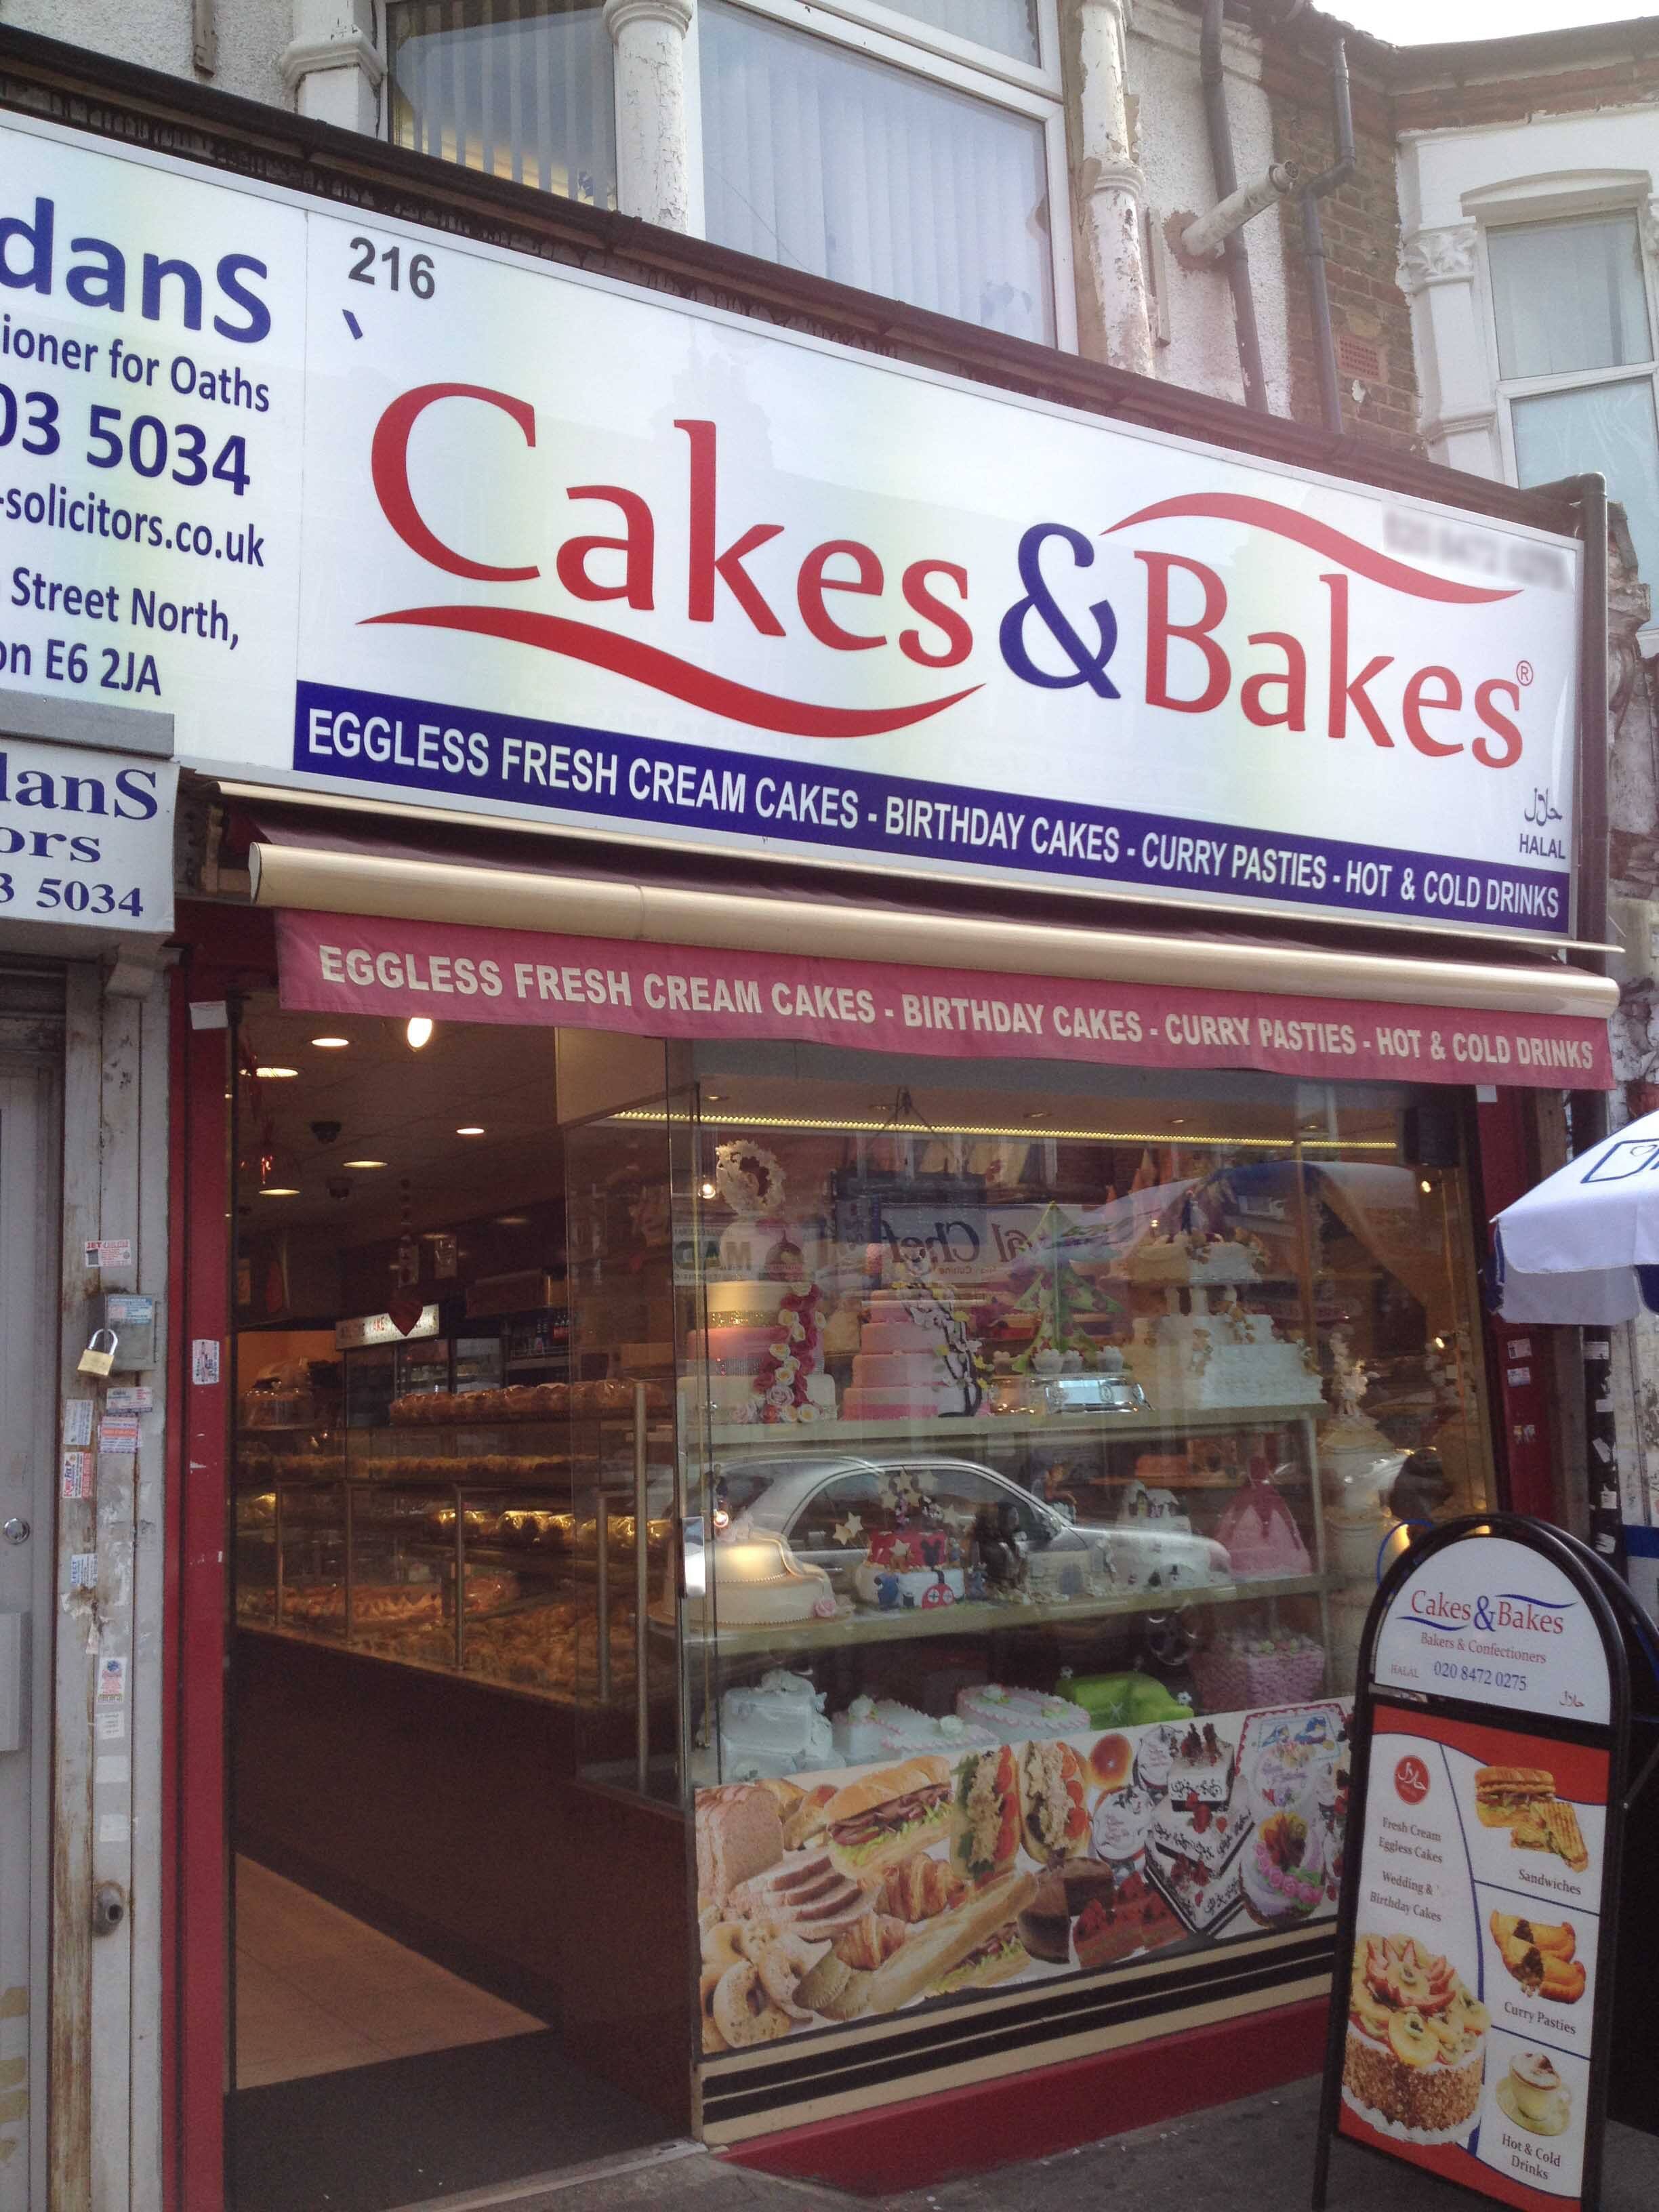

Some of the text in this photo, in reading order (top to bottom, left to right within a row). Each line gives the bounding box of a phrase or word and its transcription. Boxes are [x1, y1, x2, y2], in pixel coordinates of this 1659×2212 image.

[0, 197, 271, 343] danS
[348, 237, 436, 299] 216
[3, 314, 270, 412] ioner for Oaths
[87, 403, 250, 495] 5034
[371, 383, 973, 668] Cakes
[1000, 523, 1122, 698] &
[1134, 550, 1523, 768] Bakes
[12, 567, 239, 650] Street North,
[0, 638, 161, 695] n E6 2JA
[0, 752, 159, 820] anS
[309, 709, 489, 777] EGGLESS
[501, 738, 617, 795] FRESH
[628, 758, 745, 813] CREAM
[755, 777, 859, 829] CAKES
[885, 796, 1025, 851] BIRTHDAY
[1031, 817, 1119, 863] CAKES
[1142, 832, 1227, 876] CURRY
[1231, 844, 1327, 890] PASTIES
[1346, 860, 1392, 897] HOT
[1401, 867, 1415, 901] &
[1424, 870, 1480, 908] COLD
[1486, 879, 1559, 918] DRINKS
[0, 826, 101, 863] ors
[1519, 834, 1565, 859] HALAL
[37, 878, 143, 916] 5034
[319, 945, 503, 997] EGGLESS
[514, 962, 632, 1006] FRESH
[644, 972, 762, 1014] CREAM
[771, 983, 876, 1023] CAKES
[902, 994, 1044, 1034] BIRTHDAY
[1053, 1006, 1142, 1042] CAKES
[1165, 1013, 1250, 1046] CURRY
[1259, 1018, 1356, 1054] PASTIES
[1376, 1027, 1421, 1058] HOT
[1431, 1030, 1446, 1061] &
[1453, 1032, 1511, 1063] COLD
[1517, 1037, 1593, 1069] DRINKS
[1411, 1590, 1563, 1635] Cakes & Bakes
[1420, 1632, 1547, 1664] Bakers & Confectioners
[1391, 1664, 1419, 1679] HALAL
[1433, 1661, 1527, 1691] 020 8472 0275
[1382, 1817, 1441, 1842] Fresh Cream
[1378, 1837, 1443, 1864] Eggless Cakes
[1382, 1870, 1433, 1896] Wedding &
[1519, 1868, 1581, 1896] Sandwiches
[1370, 1891, 1441, 1922] Birthday Cakes
[1504, 2001, 1576, 2034] Curry Pasties
[1502, 2133, 1561, 2167] Hot & Cold
[1511, 2154, 1548, 2180] Drinks
